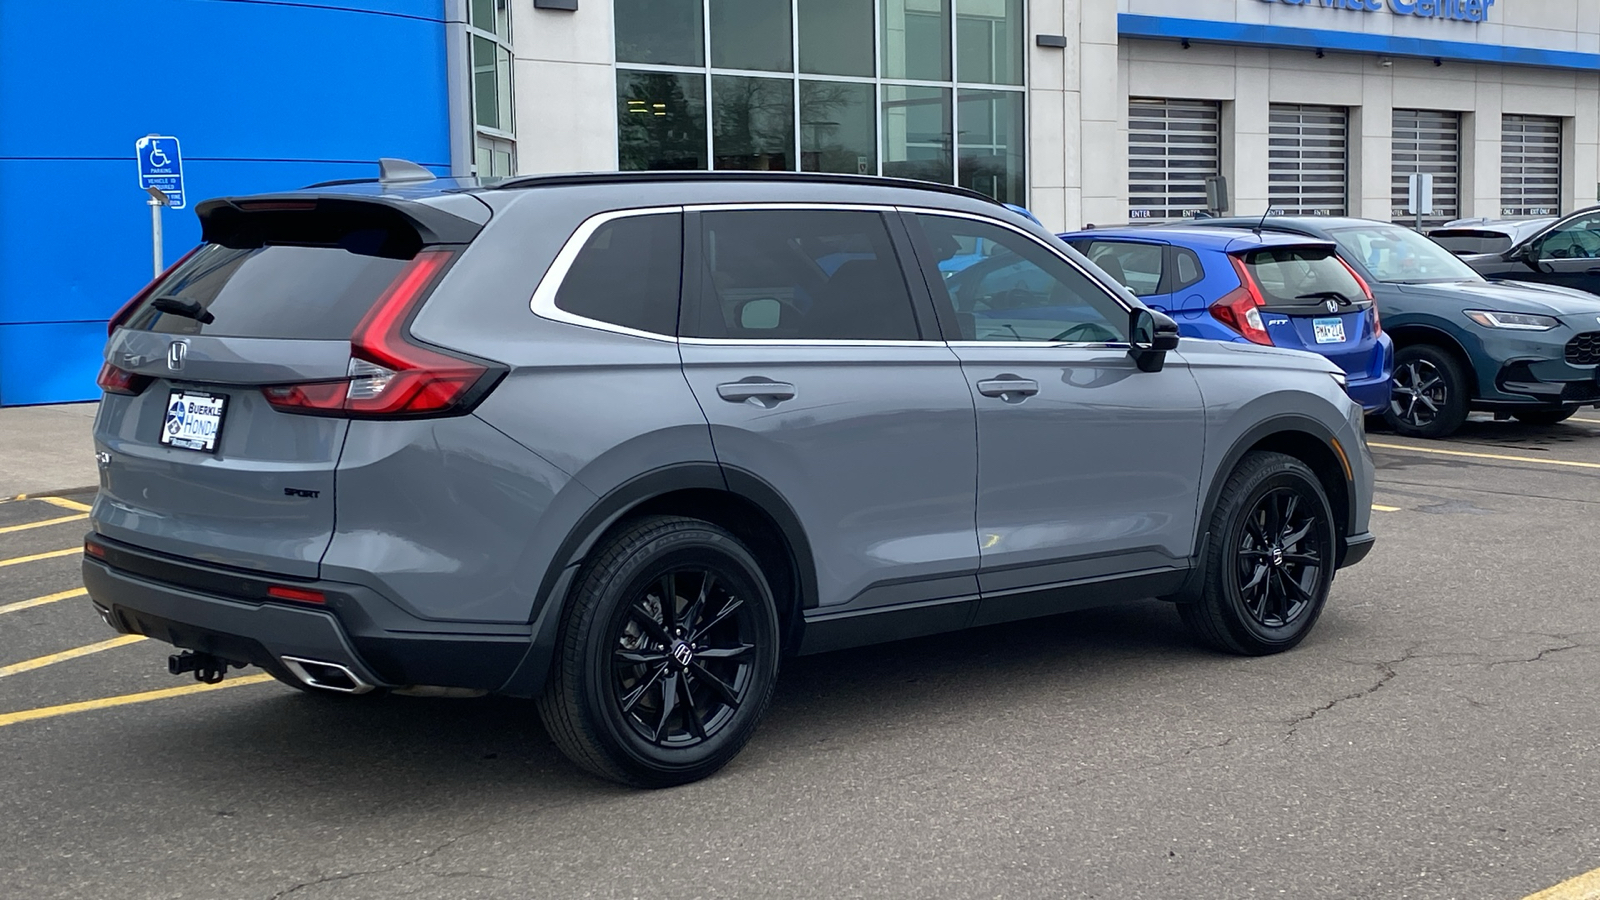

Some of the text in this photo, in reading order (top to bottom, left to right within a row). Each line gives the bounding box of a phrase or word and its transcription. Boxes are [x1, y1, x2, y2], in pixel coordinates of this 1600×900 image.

[1258, 0, 1496, 22] vice Center
[1131, 210, 1151, 218] ENTER
[188, 402, 222, 417] BUERKLE
[184, 415, 217, 436] HONDA
[284, 487, 320, 498] SPORT
